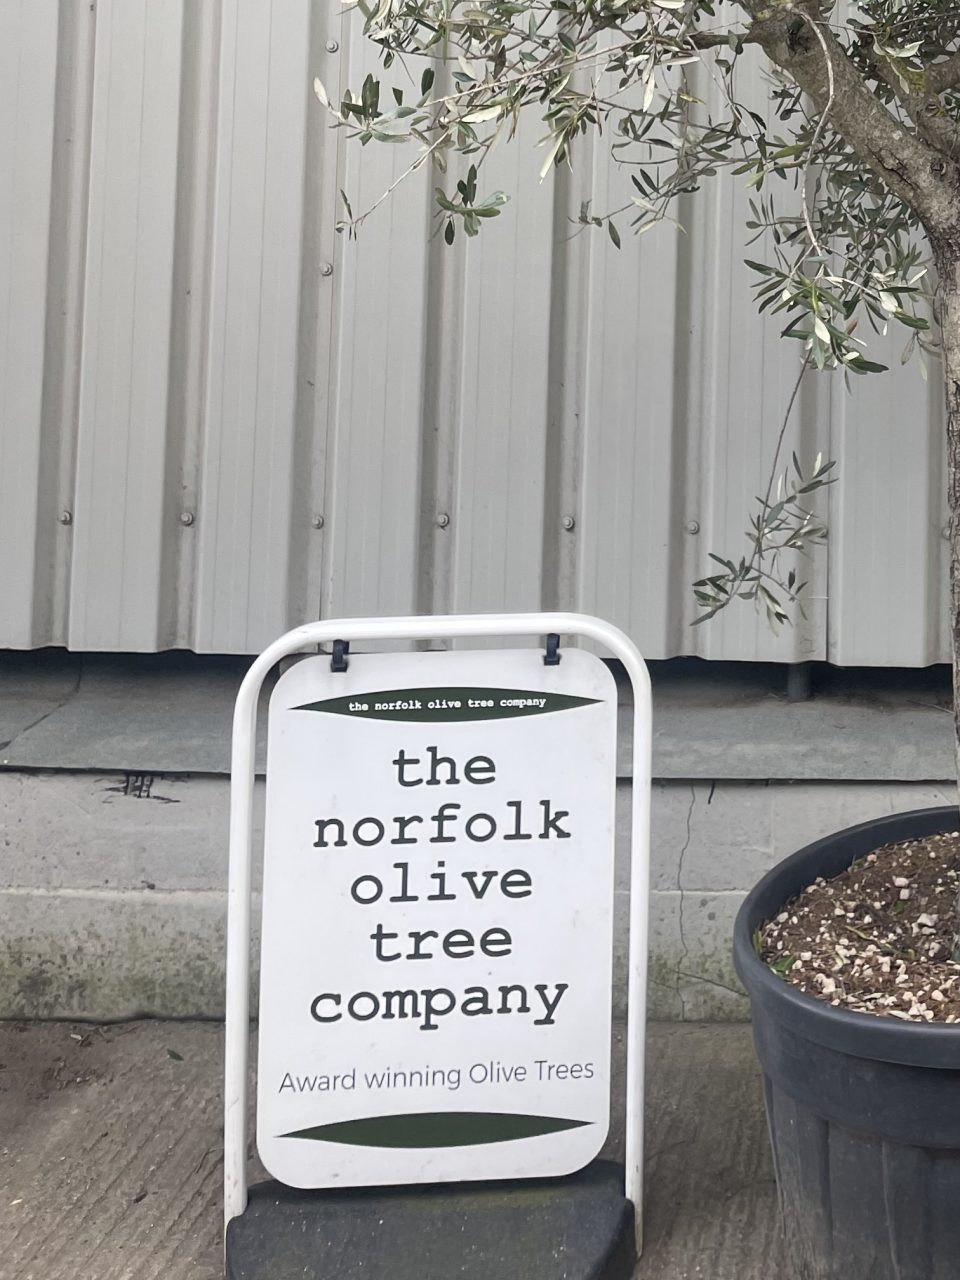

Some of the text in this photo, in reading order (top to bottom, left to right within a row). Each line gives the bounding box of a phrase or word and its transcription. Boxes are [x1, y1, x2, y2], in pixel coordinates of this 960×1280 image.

[349, 699, 546, 711] the norfolk olive tree company
[393, 747, 495, 786] the
[314, 800, 571, 847] norfolk
[351, 861, 531, 904] olive
[371, 924, 511, 961] tree
[311, 984, 568, 1030] company
[279, 1061, 593, 1093] Award winning Olive Trees
